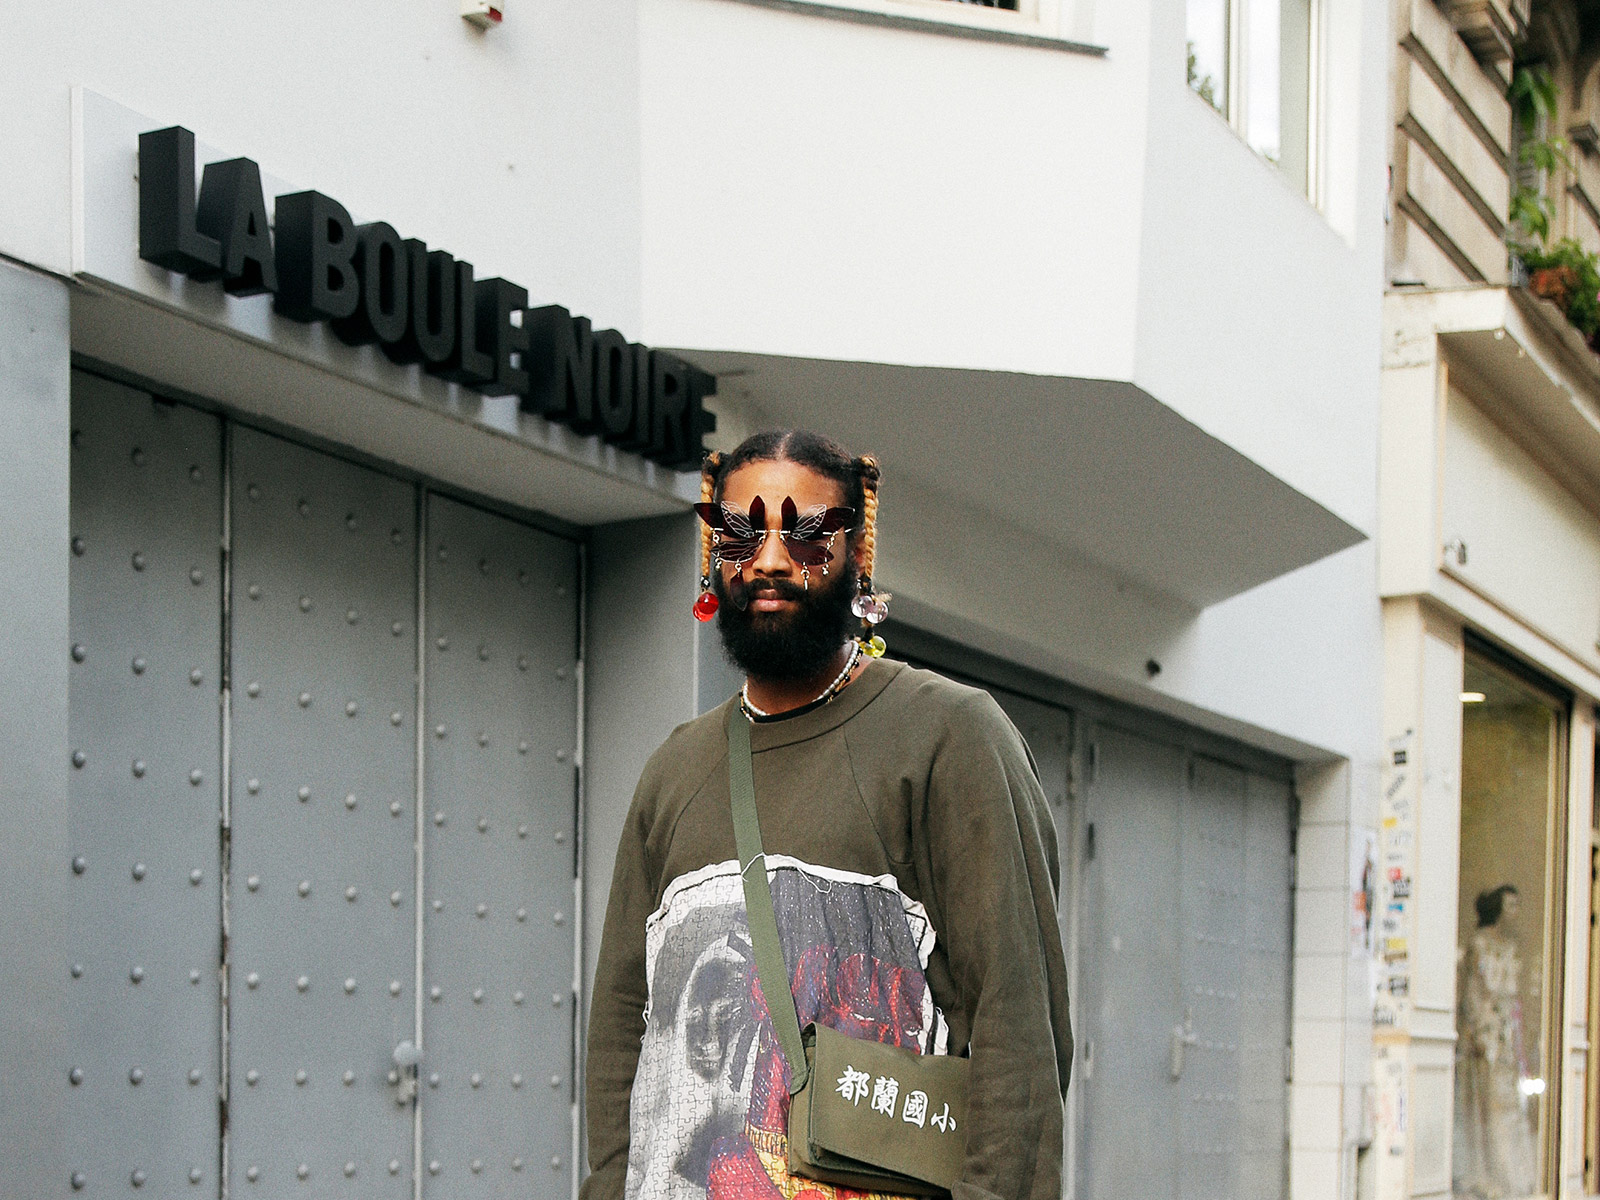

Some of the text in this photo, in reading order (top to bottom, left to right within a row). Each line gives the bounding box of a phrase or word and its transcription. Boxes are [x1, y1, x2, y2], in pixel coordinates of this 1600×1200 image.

[139, 125, 716, 472] LA BOULE NOIRE
[835, 1064, 957, 1133] 都蘭國小
